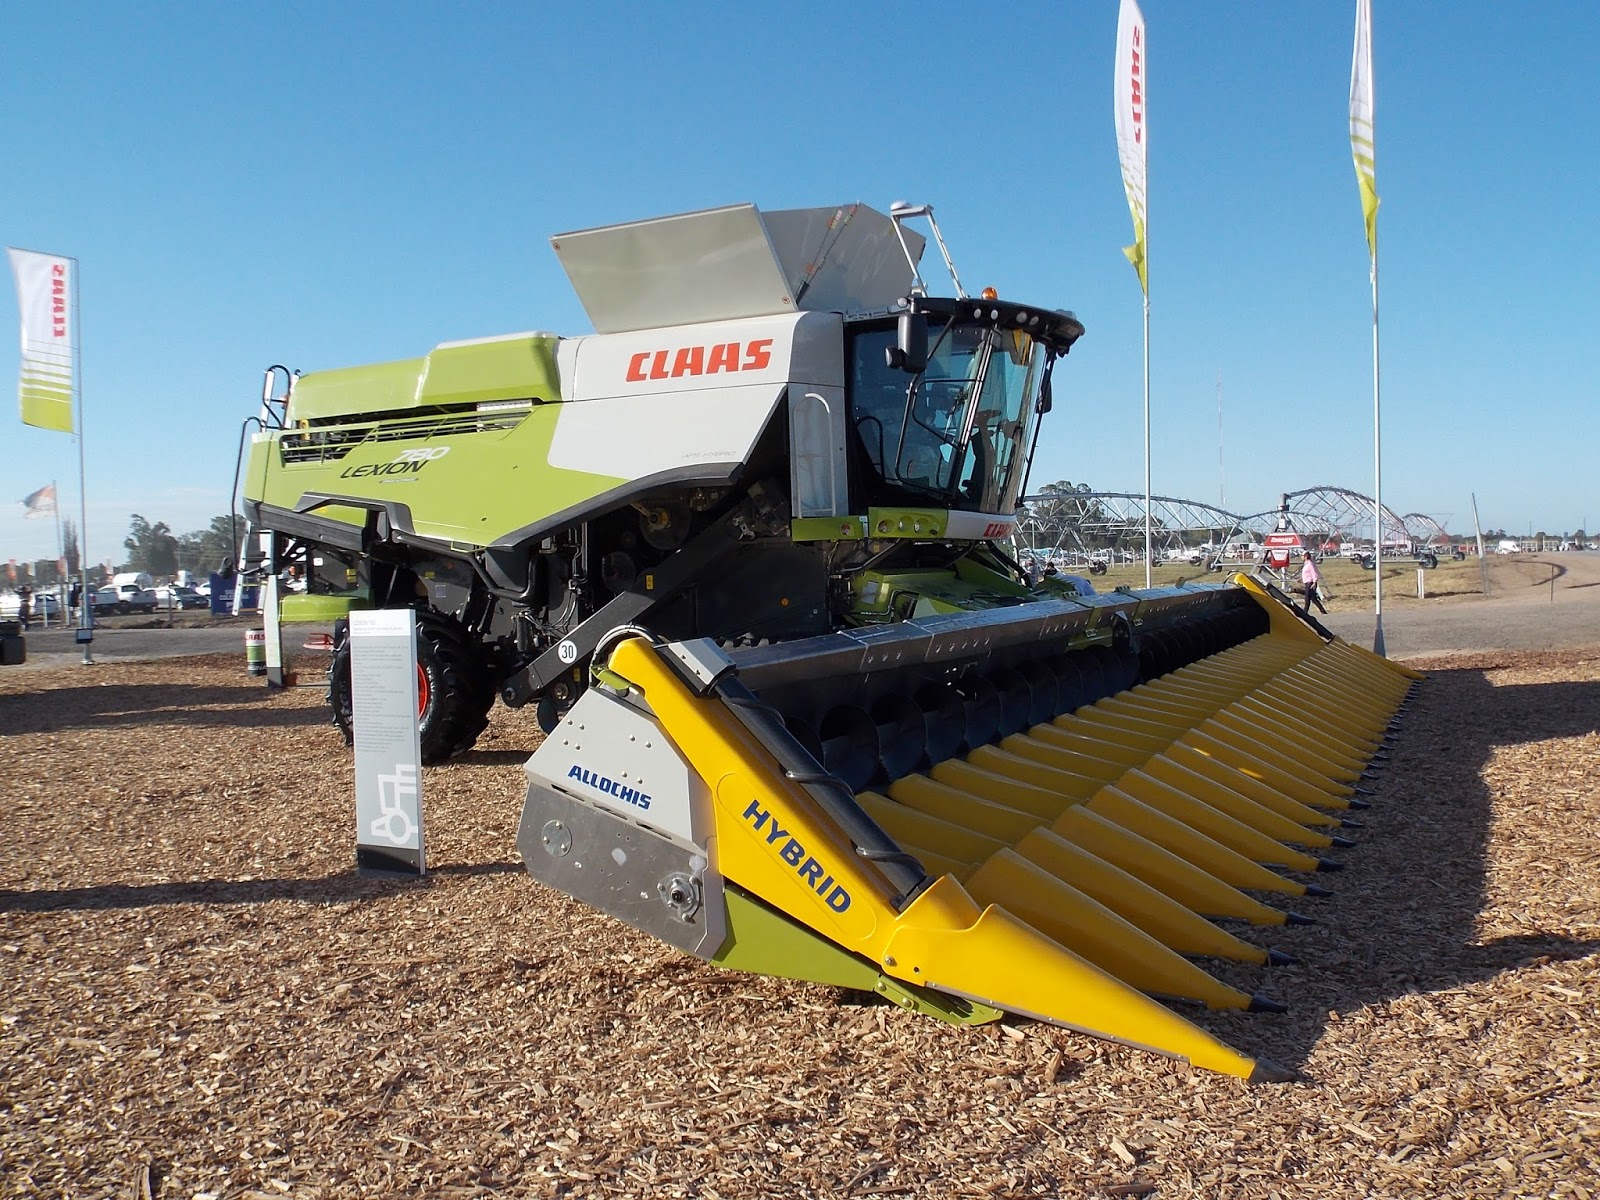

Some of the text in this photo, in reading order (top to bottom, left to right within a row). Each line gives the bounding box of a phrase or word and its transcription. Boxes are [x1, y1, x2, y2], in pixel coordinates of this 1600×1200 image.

[626, 339, 774, 383] CLAAS
[340, 459, 430, 479] LEXION
[390, 446, 451, 464] 780
[561, 645, 574, 659] 30
[567, 764, 652, 811] ALLOCHIS
[742, 799, 852, 914] HYBRID
